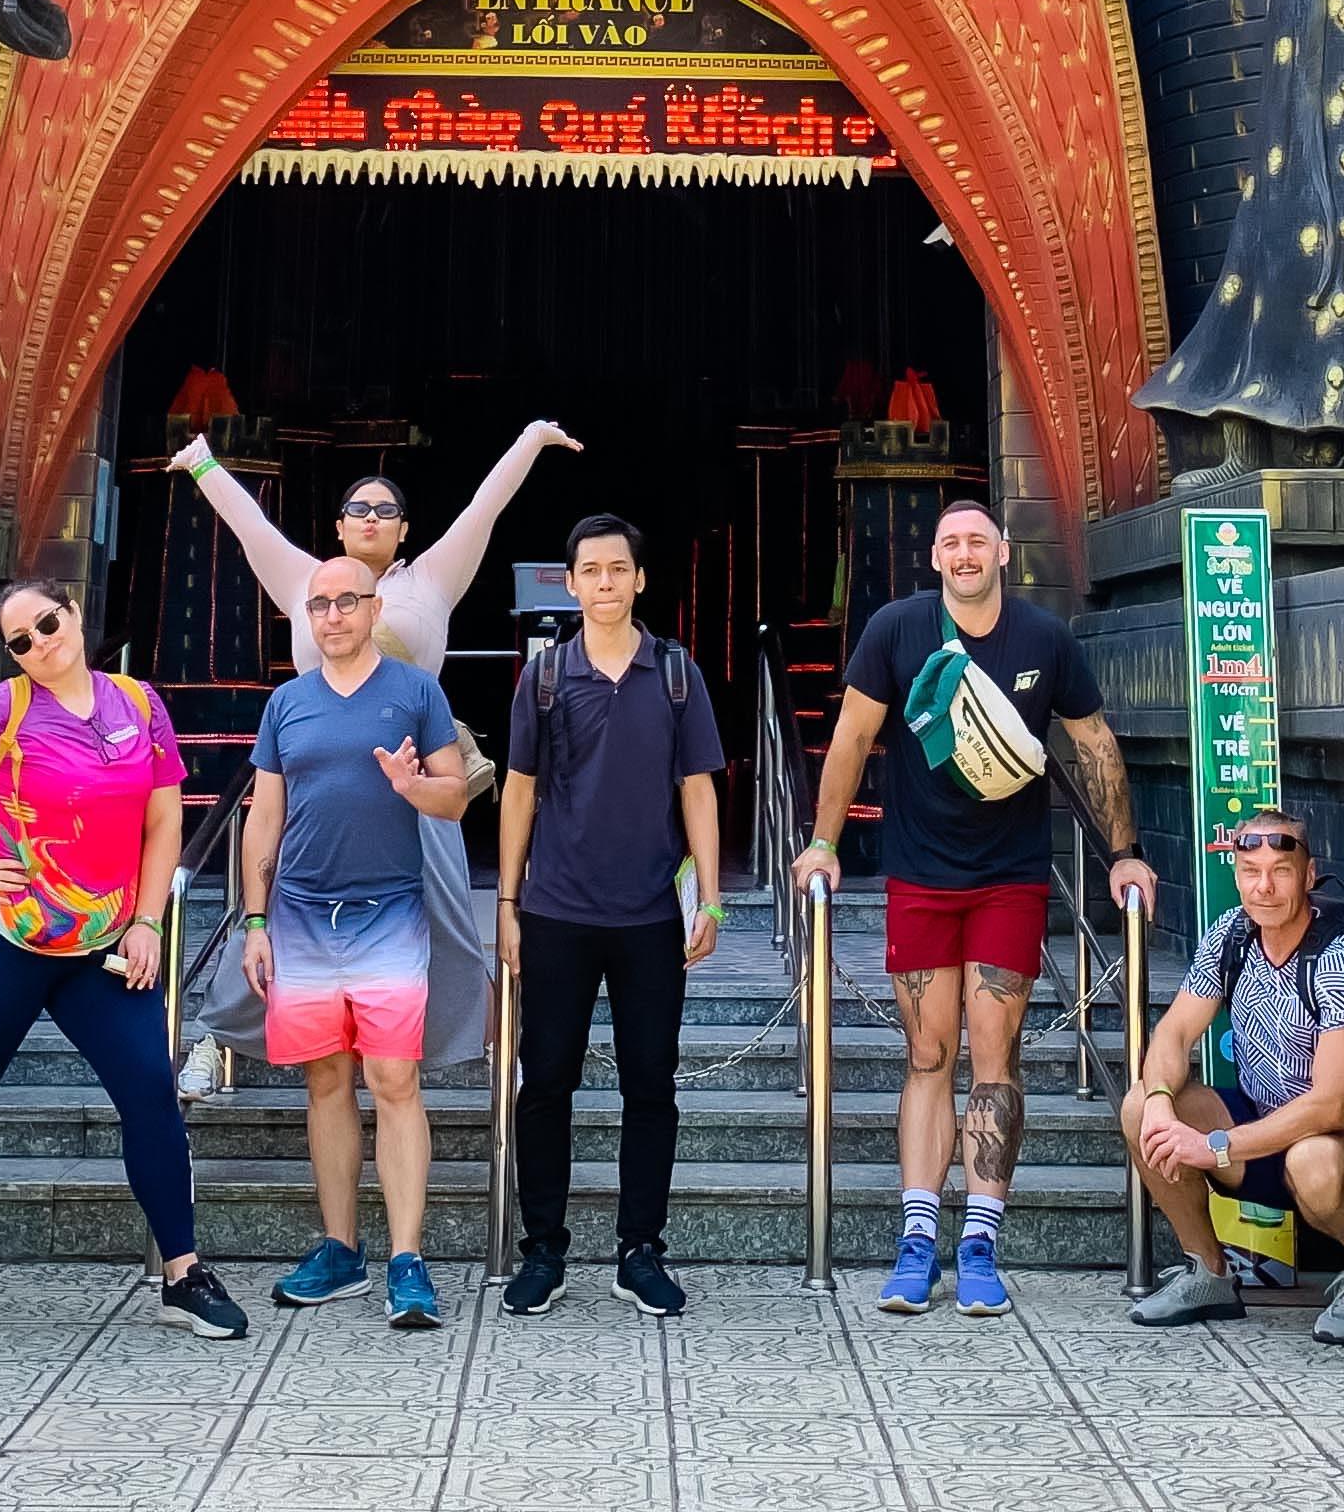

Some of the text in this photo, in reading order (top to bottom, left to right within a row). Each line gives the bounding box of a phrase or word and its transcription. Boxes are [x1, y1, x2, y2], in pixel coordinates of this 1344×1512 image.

[511, 14, 648, 46] LỐI VÀO
[1216, 574, 1244, 595] VÉ
[1197, 597, 1262, 619] NGƯỜI
[1212, 620, 1252, 641] LỚN
[1206, 653, 1263, 677] 1m4
[1212, 682, 1259, 697] 140cm
[1220, 763, 1249, 782] EM
